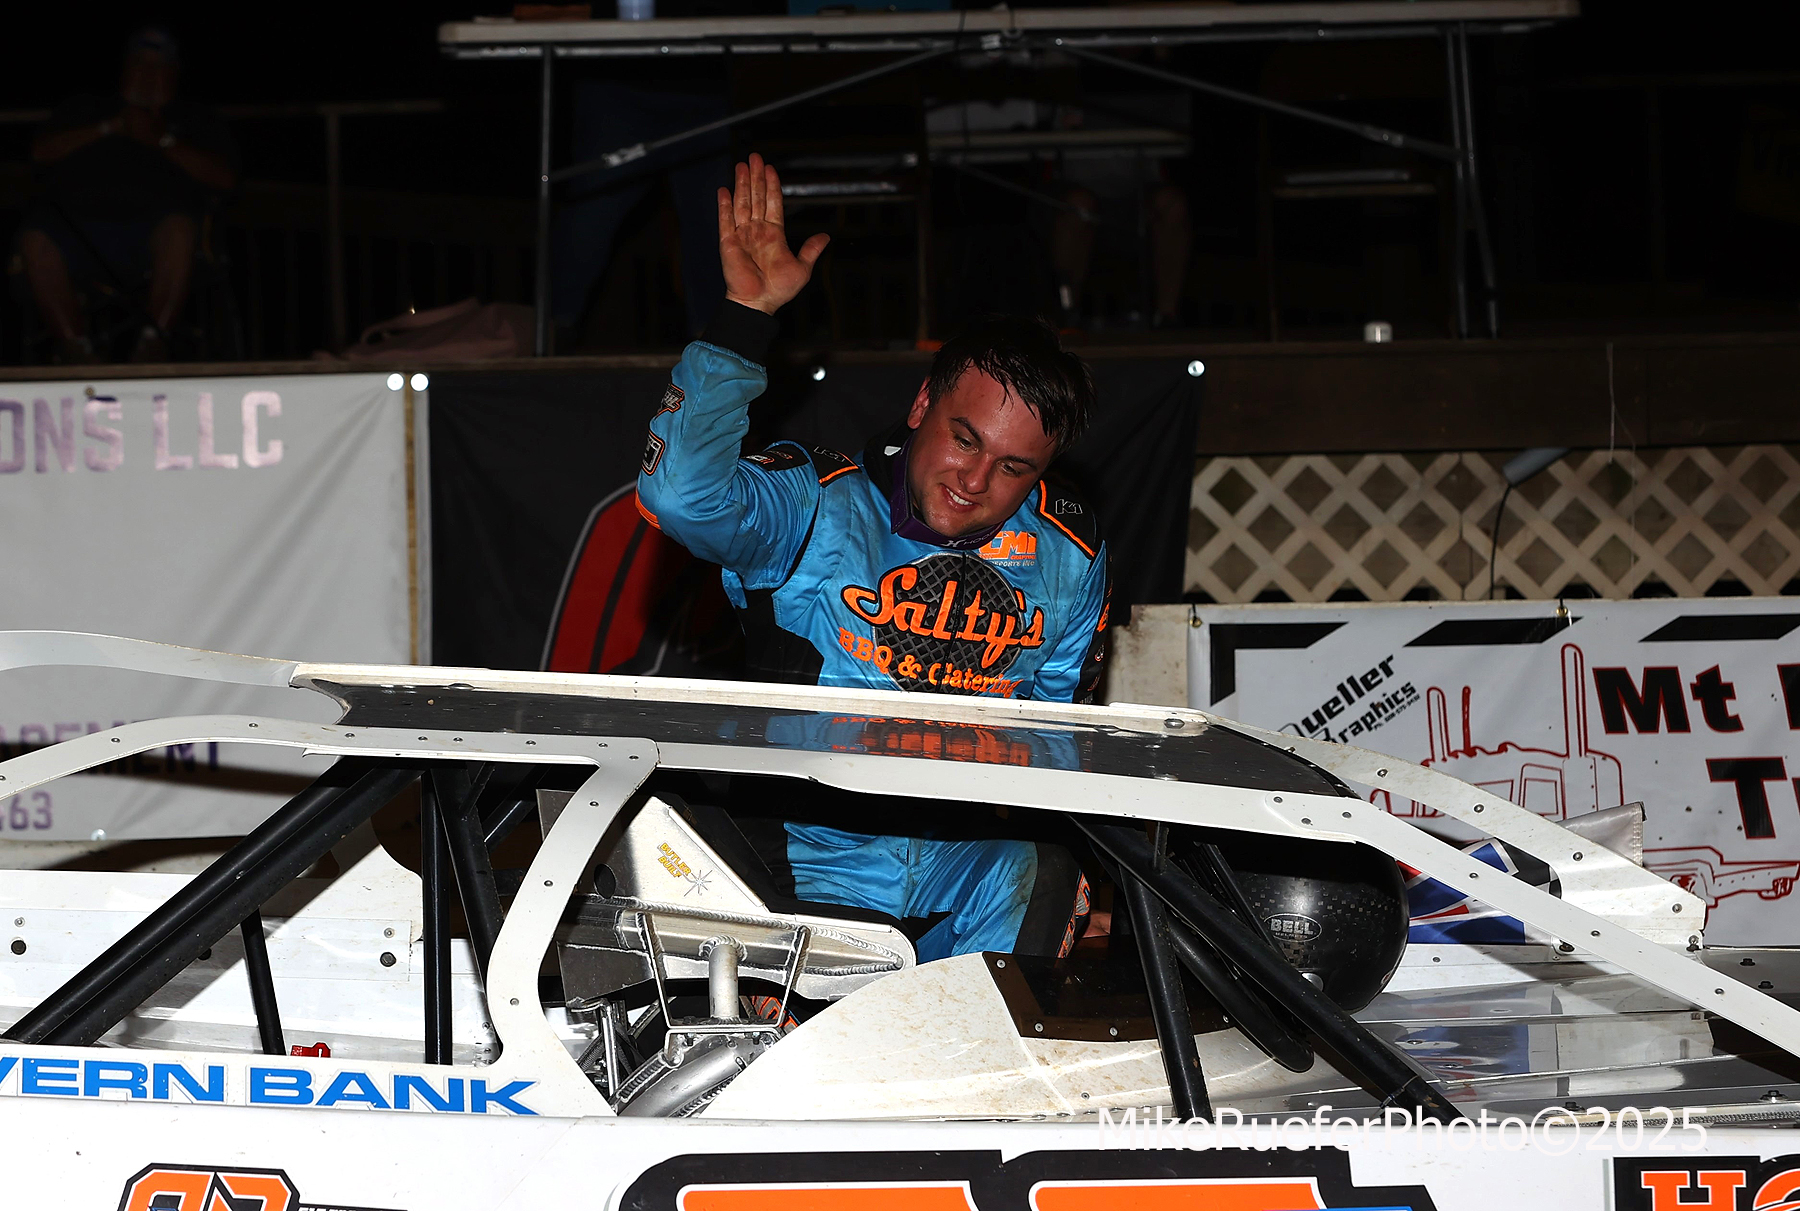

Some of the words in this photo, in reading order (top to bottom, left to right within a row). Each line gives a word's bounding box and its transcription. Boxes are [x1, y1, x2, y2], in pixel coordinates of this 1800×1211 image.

[152, 390, 285, 471] LLC
[841, 564, 1045, 669] Salty's
[838, 627, 894, 674] BBQ
[897, 654, 922, 679] &
[1592, 664, 1745, 735] Mt
[0, 789, 53, 831] 63
[657, 855, 683, 878] BUILT
[660, 842, 692, 877] BUTLER
[1270, 918, 1314, 935] BELL
[249, 1067, 544, 1116] BANK
